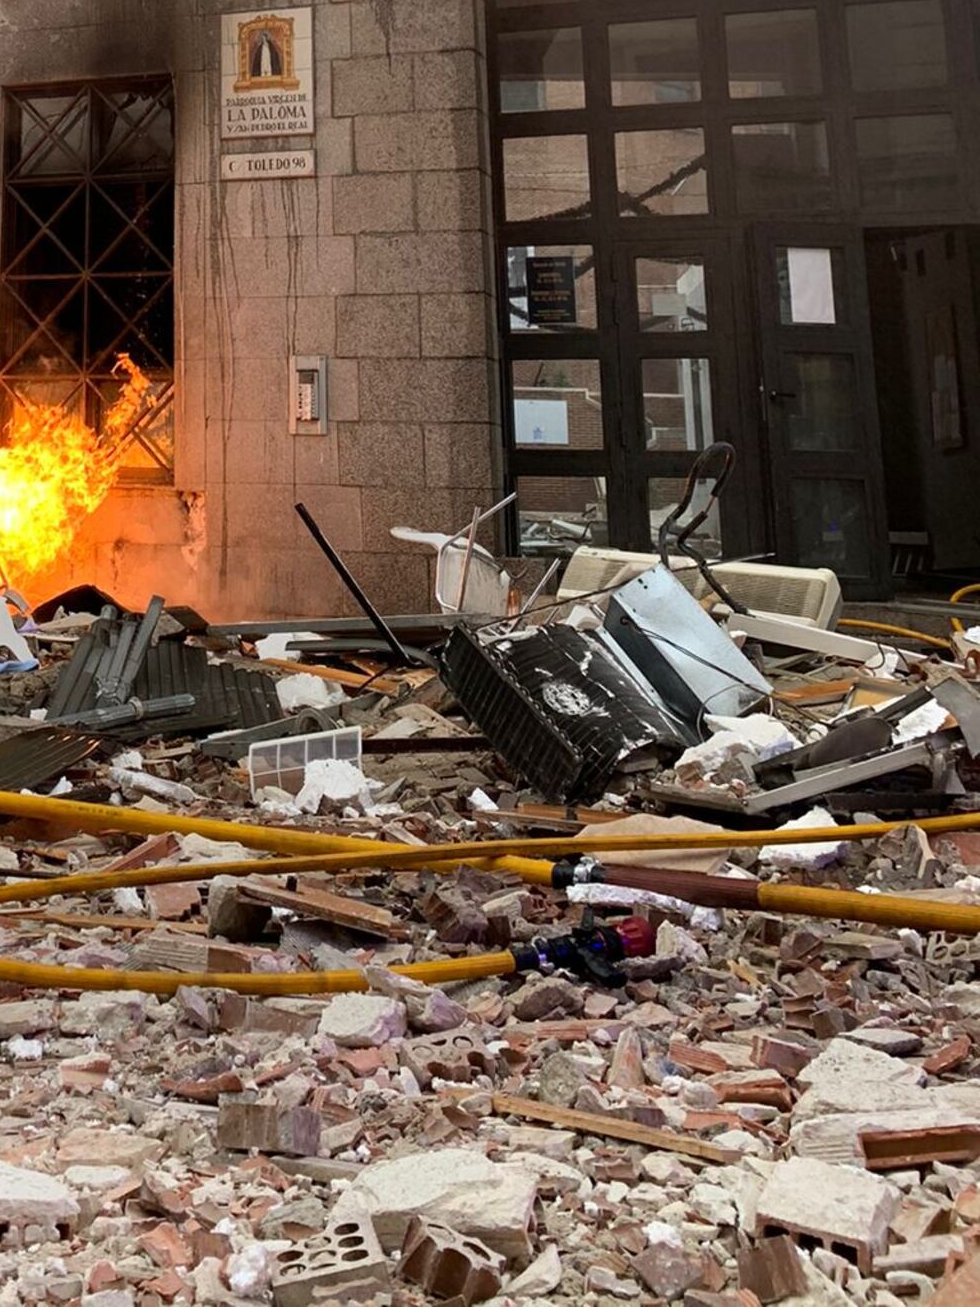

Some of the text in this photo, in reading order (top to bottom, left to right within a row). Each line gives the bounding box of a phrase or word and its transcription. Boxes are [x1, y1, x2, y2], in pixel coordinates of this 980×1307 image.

[228, 105, 307, 122] LA PALOMA
[246, 158, 290, 172] TOLEDO
[292, 156, 306, 170] 98
